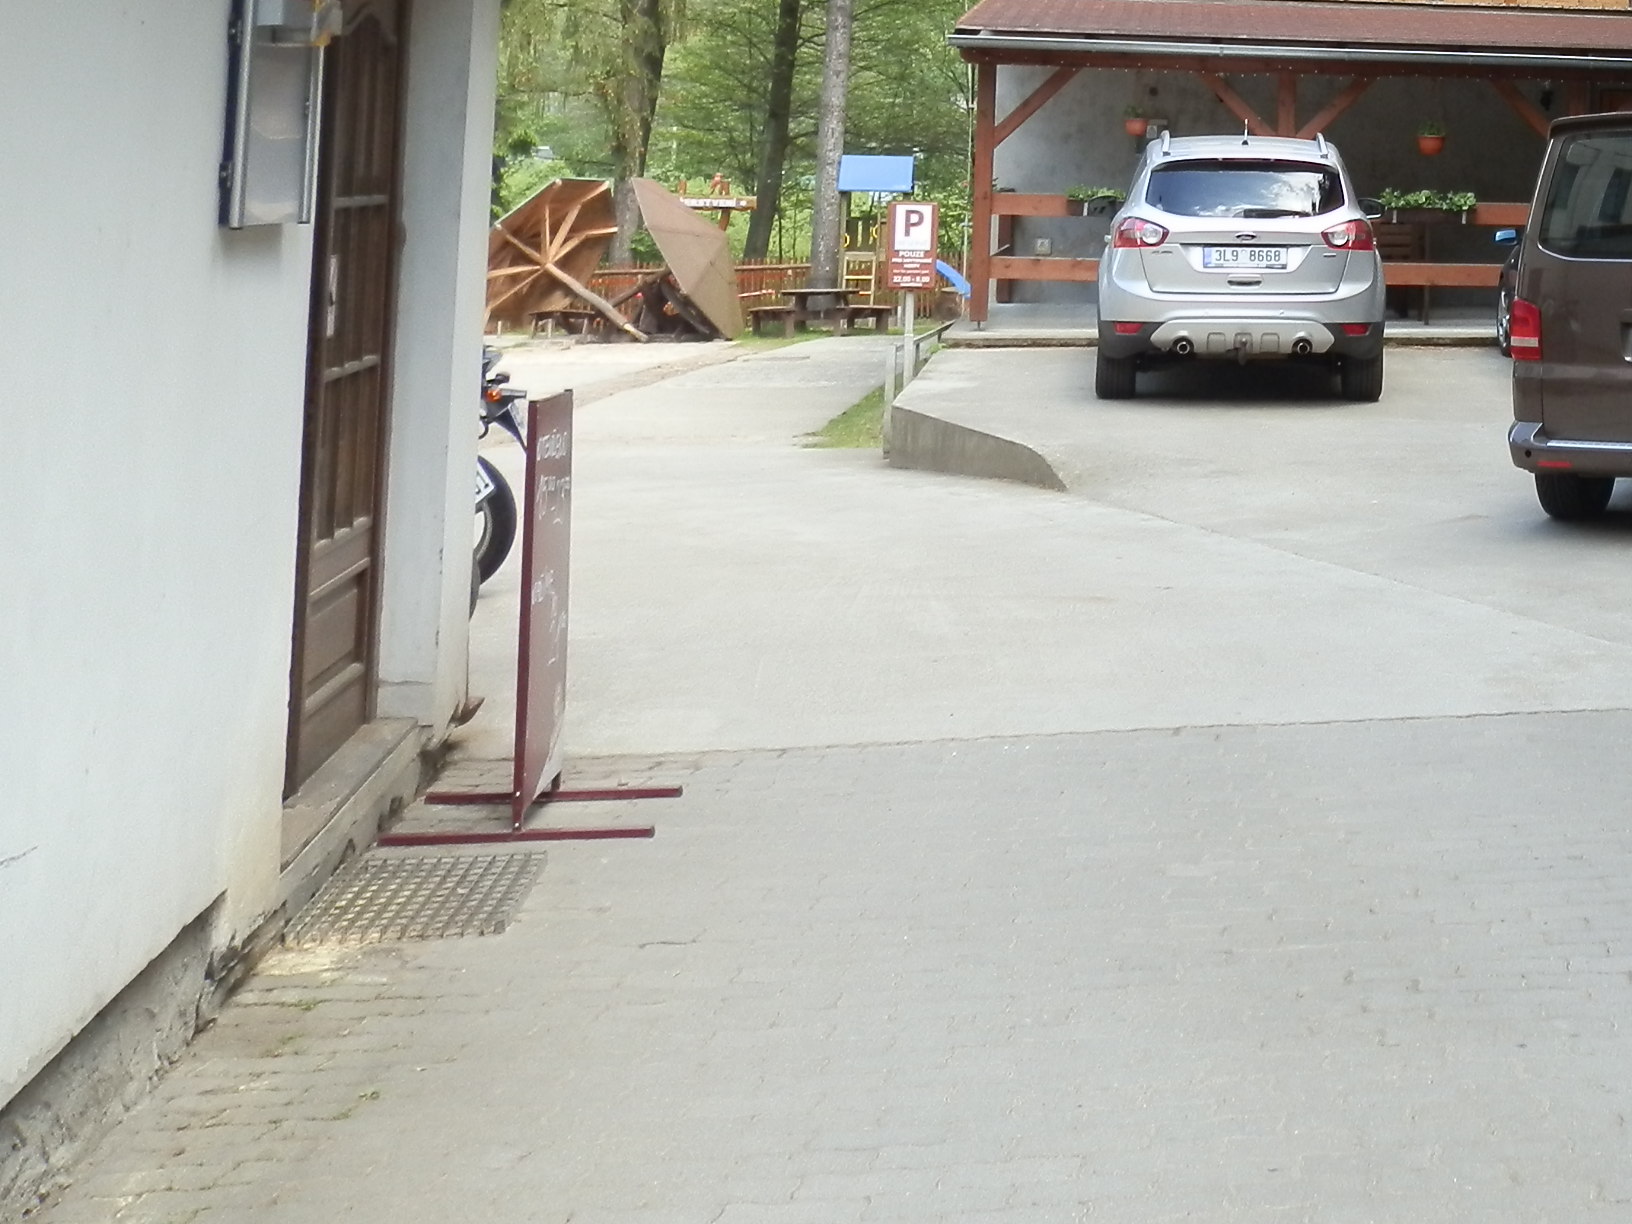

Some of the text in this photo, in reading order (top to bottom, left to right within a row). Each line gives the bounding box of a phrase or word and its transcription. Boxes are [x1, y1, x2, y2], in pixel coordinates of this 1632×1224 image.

[904, 209, 924, 237] P
[1215, 249, 1281, 263] 3L9 8668
